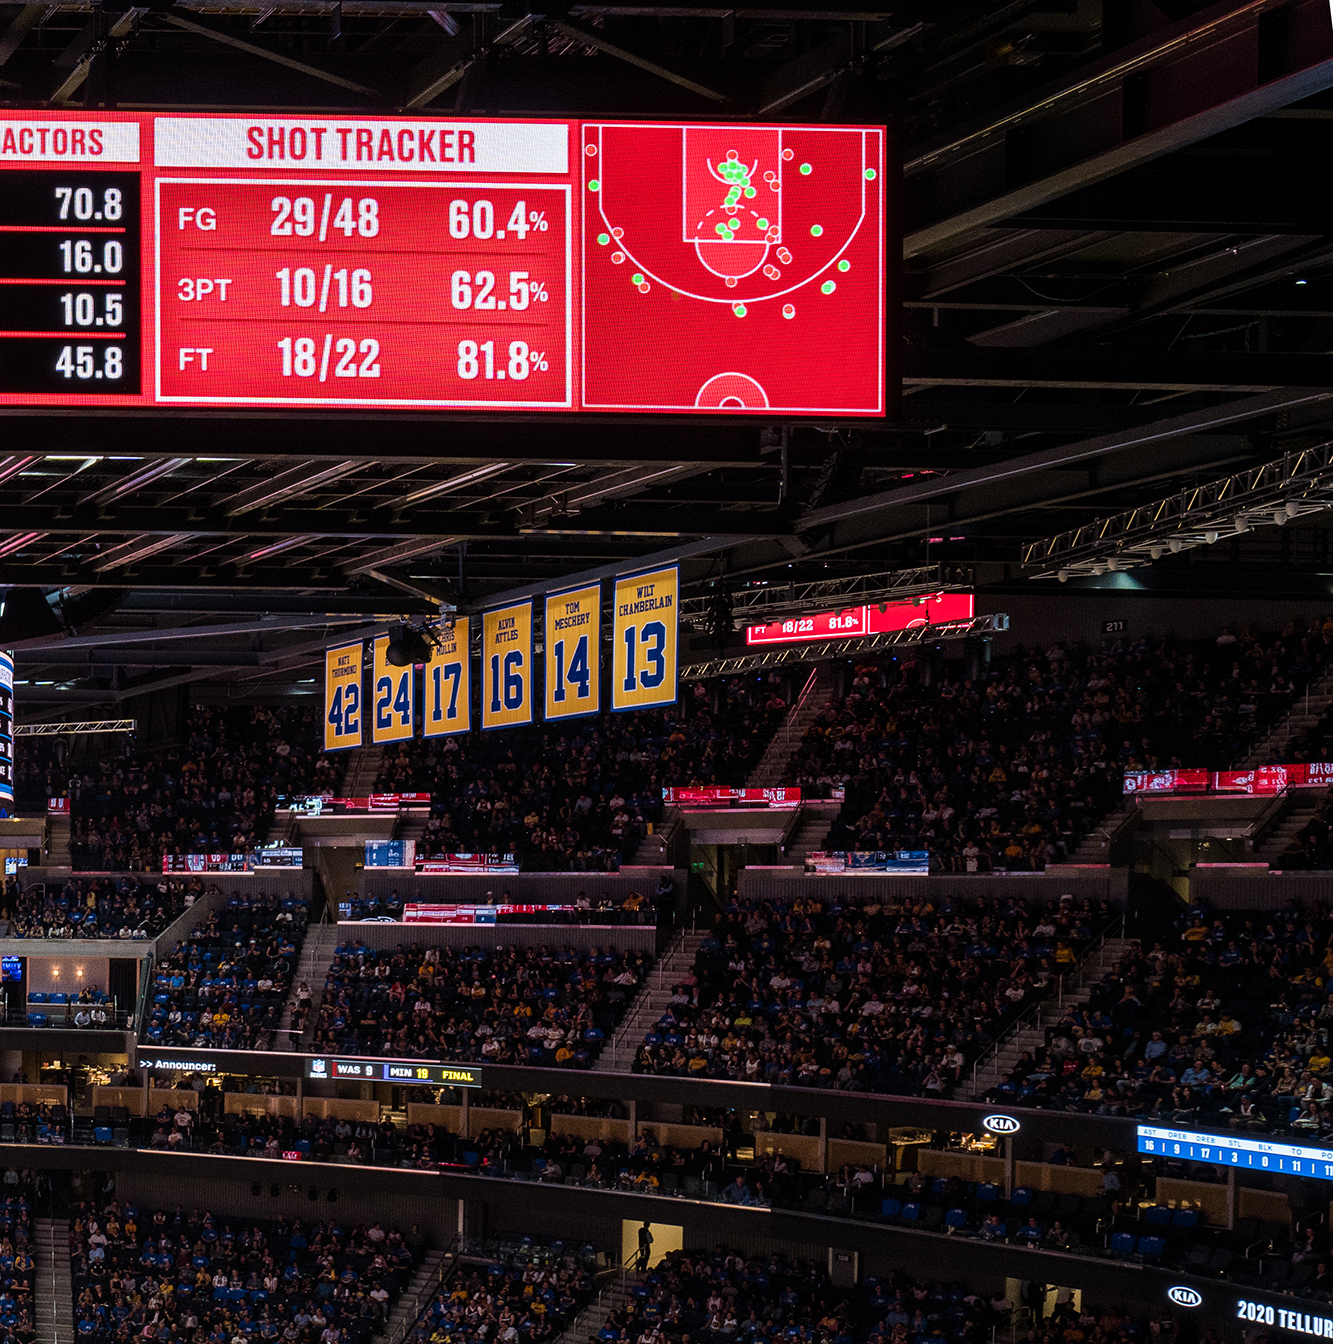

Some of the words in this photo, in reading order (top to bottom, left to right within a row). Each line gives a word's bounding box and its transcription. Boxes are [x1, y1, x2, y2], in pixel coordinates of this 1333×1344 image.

[246, 127, 325, 161] SHOT
[337, 129, 476, 163] TRACKER
[636, 584, 655, 599] WILT
[565, 601, 580, 615] TOM
[619, 595, 673, 617] CHAMBERLAIN
[554, 612, 591, 630] MESCHERY
[754, 627, 767, 635] FT
[828, 616, 859, 630] 81.8%
[1105, 622, 1123, 631] 211
[495, 629, 519, 644] ATTLES
[623, 620, 667, 692] 13
[553, 634, 591, 703] 14
[490, 649, 524, 713] 16
[376, 671, 411, 729] 24
[432, 662, 462, 722] 17
[328, 682, 360, 737] 42
[155, 1059, 216, 1072] Announcer:
[337, 1065, 361, 1075] WAS
[390, 1067, 413, 1078] MIN
[416, 1068, 429, 1079] 19
[442, 1071, 474, 1081] FINAL
[1237, 1300, 1275, 1325] 2020
